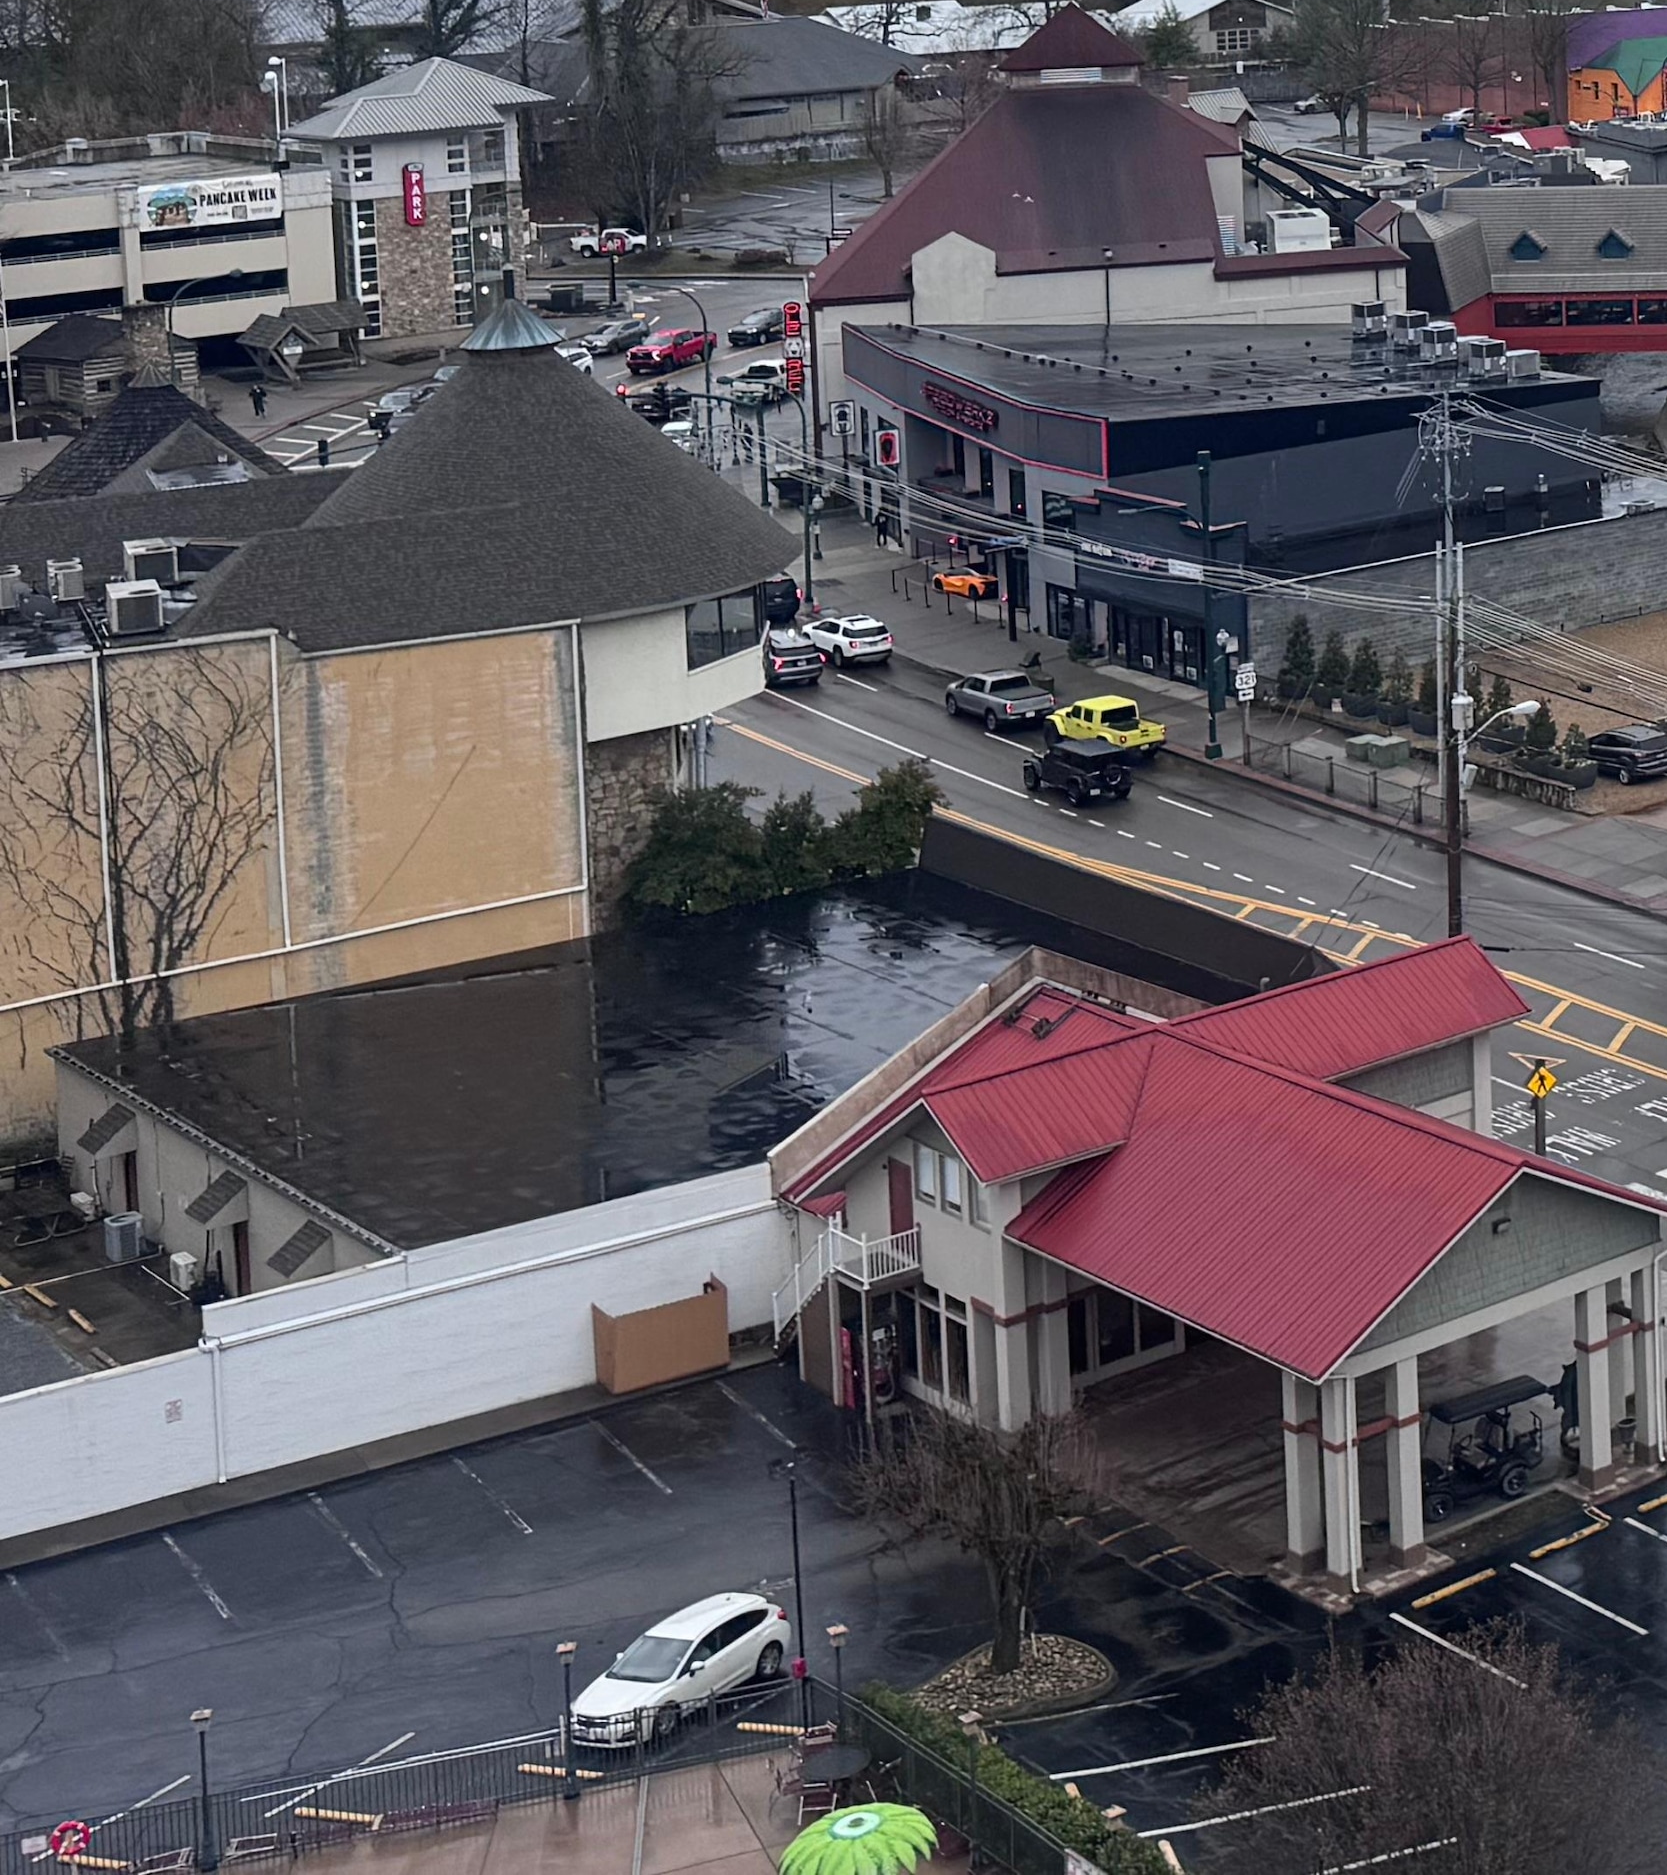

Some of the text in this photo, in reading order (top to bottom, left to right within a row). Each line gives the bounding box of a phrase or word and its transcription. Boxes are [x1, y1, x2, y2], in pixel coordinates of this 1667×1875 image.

[200, 187, 277, 207] PANCAKE WEEK
[411, 172, 423, 219] PARK
[1237, 674, 1255, 687] 321
